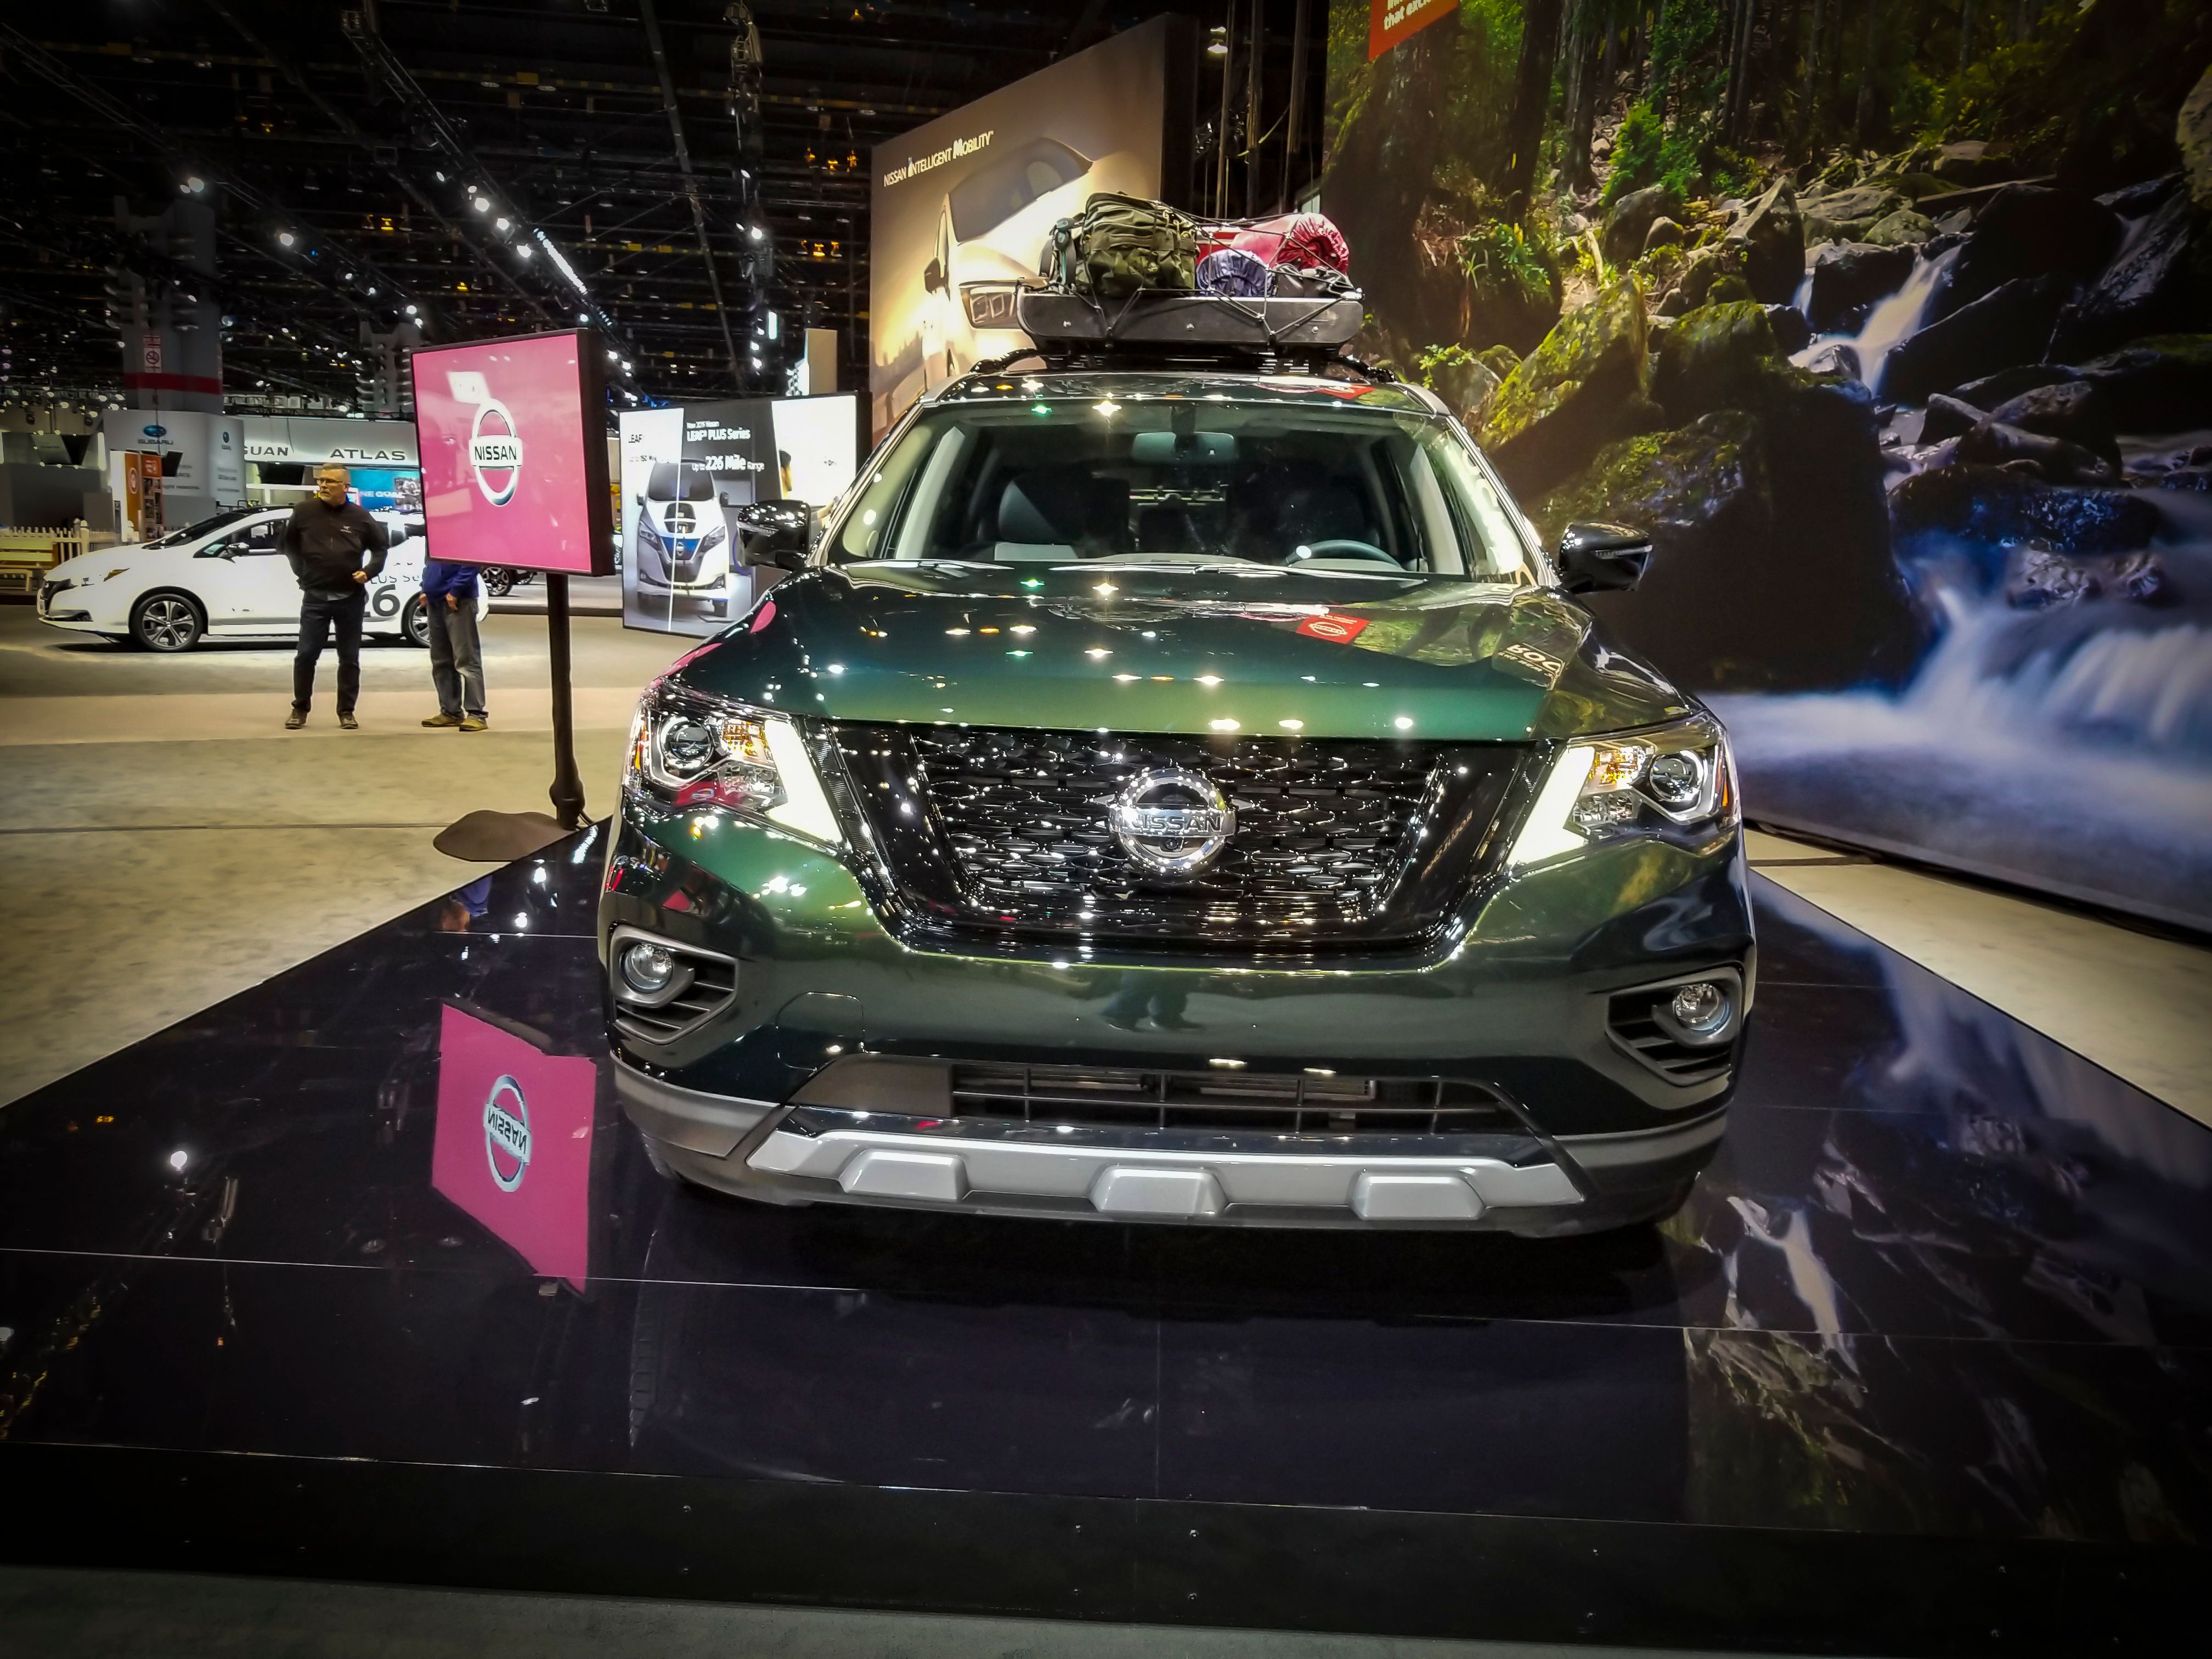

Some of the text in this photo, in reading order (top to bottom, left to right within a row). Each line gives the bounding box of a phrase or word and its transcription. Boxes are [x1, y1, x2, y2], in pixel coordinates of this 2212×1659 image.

[883, 166, 907, 187] NISSAN
[907, 146, 953, 178] INTELLIGENT
[330, 448, 406, 461] ATLAS
[475, 445, 517, 460] NISSAN
[705, 455, 724, 471] 226
[725, 453, 746, 471] Mile
